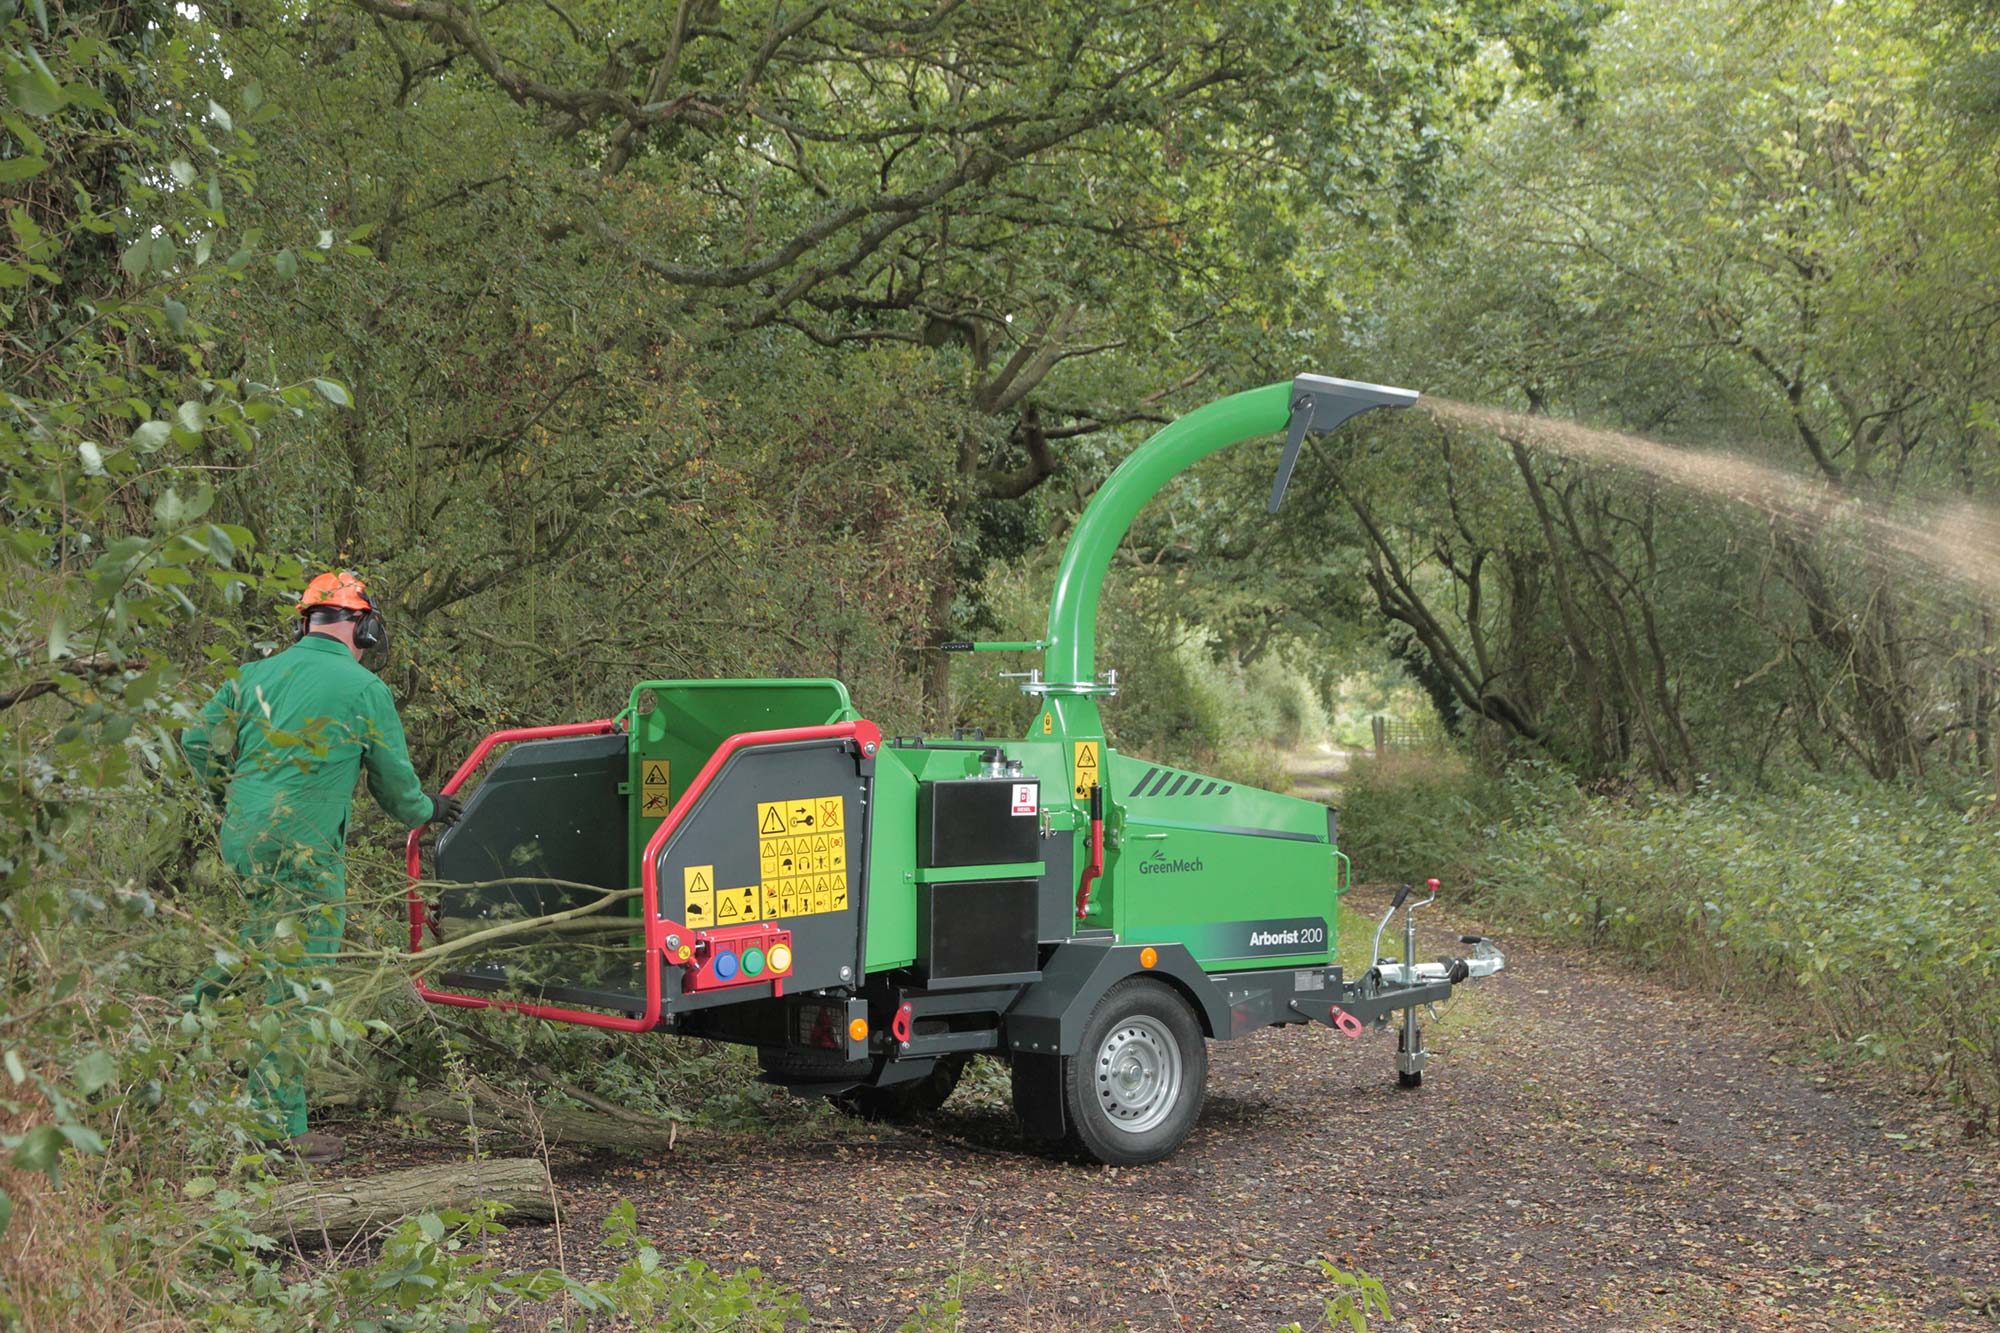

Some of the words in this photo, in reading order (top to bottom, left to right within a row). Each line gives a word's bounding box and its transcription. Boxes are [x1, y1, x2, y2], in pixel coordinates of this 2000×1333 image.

[1139, 856, 1203, 874] GreenMech
[1249, 930, 1299, 946] Arborist
[1300, 928, 1323, 943] 200
